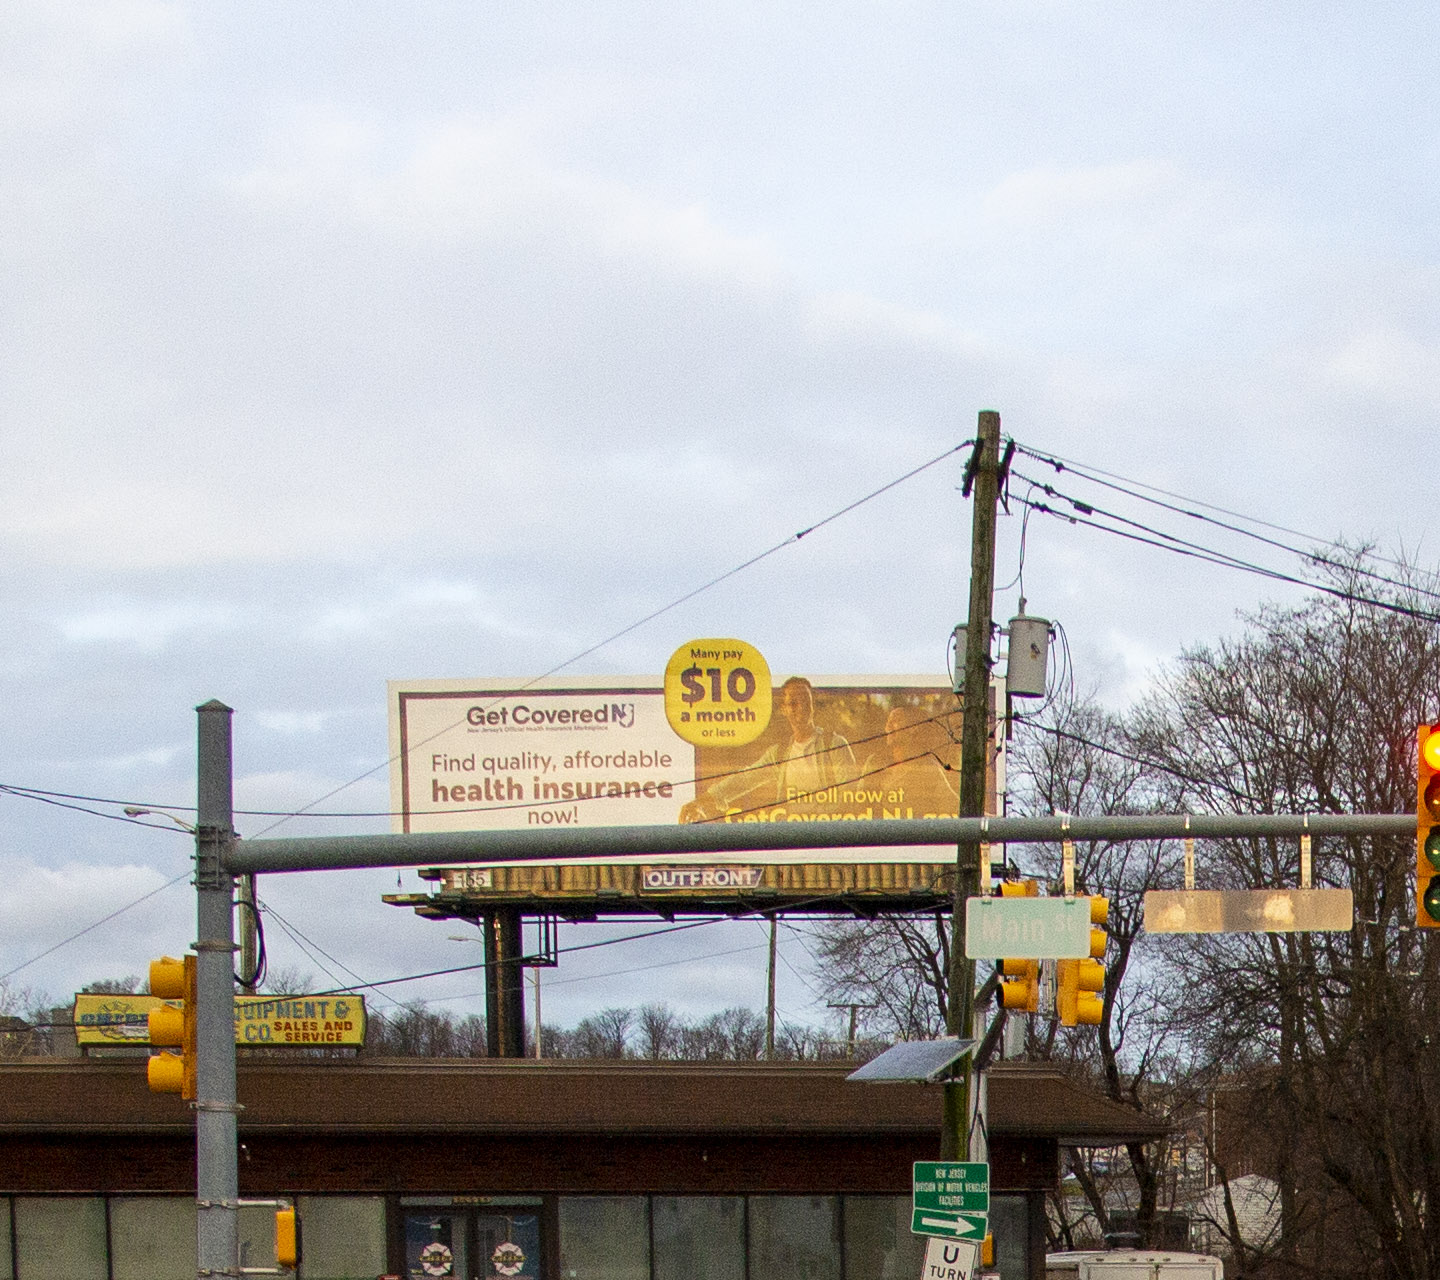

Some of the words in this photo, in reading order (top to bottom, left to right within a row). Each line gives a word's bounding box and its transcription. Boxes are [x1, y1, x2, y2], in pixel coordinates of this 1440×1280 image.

[690, 648, 720, 660] Many
[723, 650, 743, 660] pay
[681, 662, 756, 708] $10
[466, 706, 508, 726] Get
[511, 704, 608, 724] Covered
[680, 711, 691, 722] a
[696, 707, 756, 722] month
[702, 729, 714, 737] or
[716, 727, 736, 737] less
[432, 753, 476, 772] Find
[482, 752, 558, 775] quality,
[563, 750, 673, 771] affordable
[431, 776, 524, 802] health
[533, 775, 673, 800] insurance
[786, 787, 838, 804] Enroll
[842, 789, 883, 803] now
[888, 787, 905, 803] at
[528, 806, 578, 825] now!
[647, 871, 757, 886] OUTFRONT
[982, 914, 1045, 942] Main
[334, 1001, 351, 1019] &
[244, 1023, 274, 1042] CO.
[273, 1021, 318, 1031] SALES
[324, 1020, 353, 1031] AND
[285, 1031, 342, 1042] SERVICE
[943, 1245, 960, 1264] U
